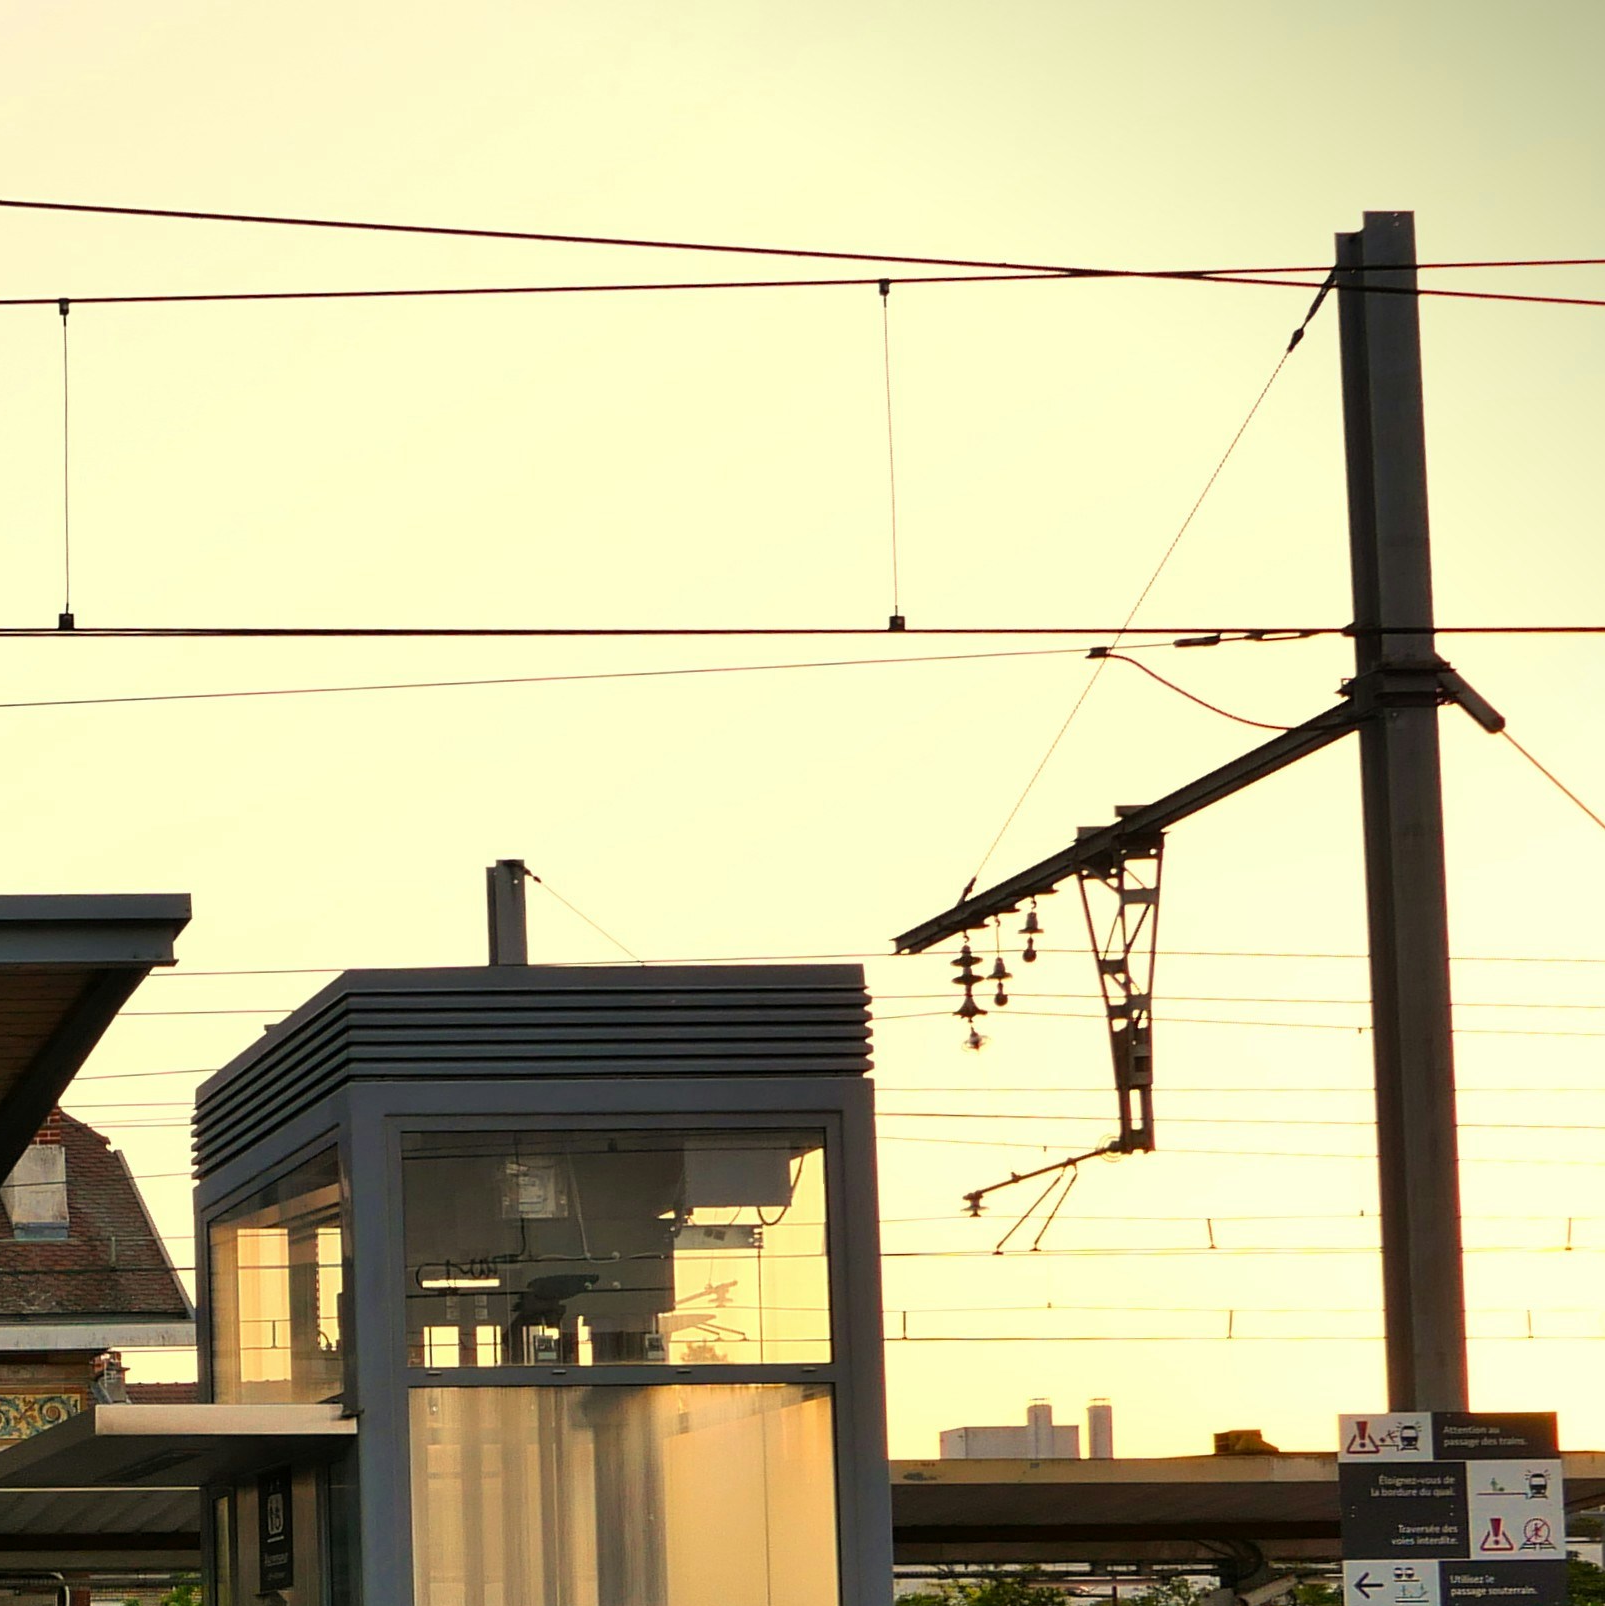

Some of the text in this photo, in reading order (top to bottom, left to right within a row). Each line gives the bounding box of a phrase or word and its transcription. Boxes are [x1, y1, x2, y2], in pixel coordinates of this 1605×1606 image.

[1443, 1425, 1487, 1434] Attention
[1444, 1438, 1480, 1448] passage
[1481, 1436, 1498, 1445] des
[1443, 1476, 1456, 1485] de
[1370, 1487, 1380, 1496] la
[1381, 1487, 1418, 1496] bordure
[1419, 1488, 1432, 1496] du
[1442, 1524, 1458, 1533] des
[1391, 1536, 1415, 1545] voies
[1451, 1587, 1486, 1598] passage
